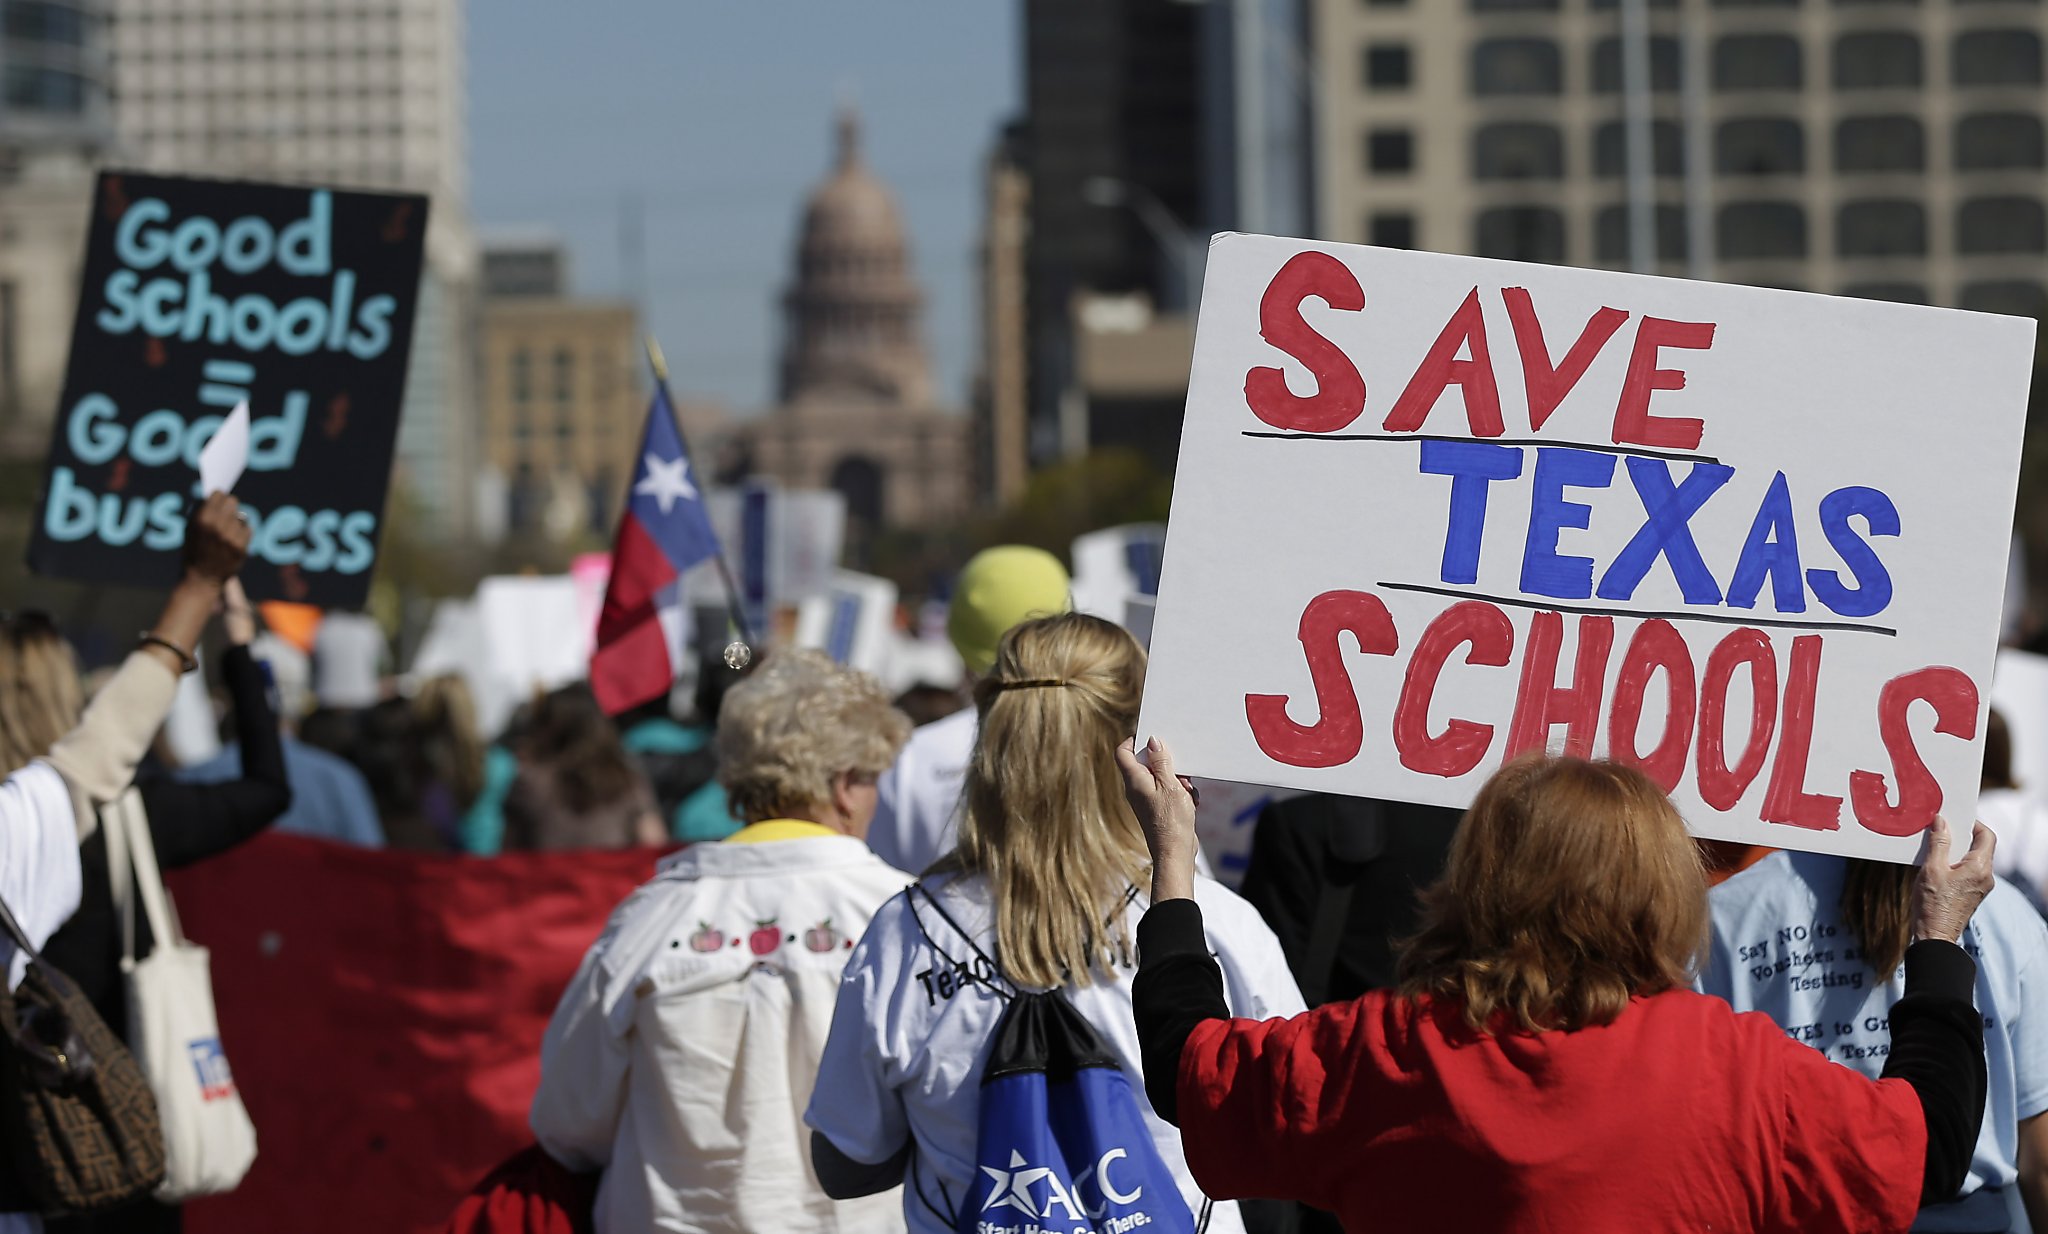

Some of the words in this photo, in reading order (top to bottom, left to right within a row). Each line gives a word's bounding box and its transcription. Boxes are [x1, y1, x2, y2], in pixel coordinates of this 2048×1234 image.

[114, 188, 333, 276] Good
[97, 268, 398, 360] schools
[1245, 250, 1717, 449] SAVE
[1420, 438, 1901, 616] TEXAS
[1245, 589, 1979, 837] SCHOOLS
[1739, 940, 1768, 962] Say
[1777, 926, 1807, 945] NO
[1817, 924, 1837, 939] to
[1751, 950, 1834, 982] Vouchers
[1790, 971, 1864, 992] Testing
[1787, 1023, 1824, 1041] YES
[1834, 1021, 1853, 1036] to
